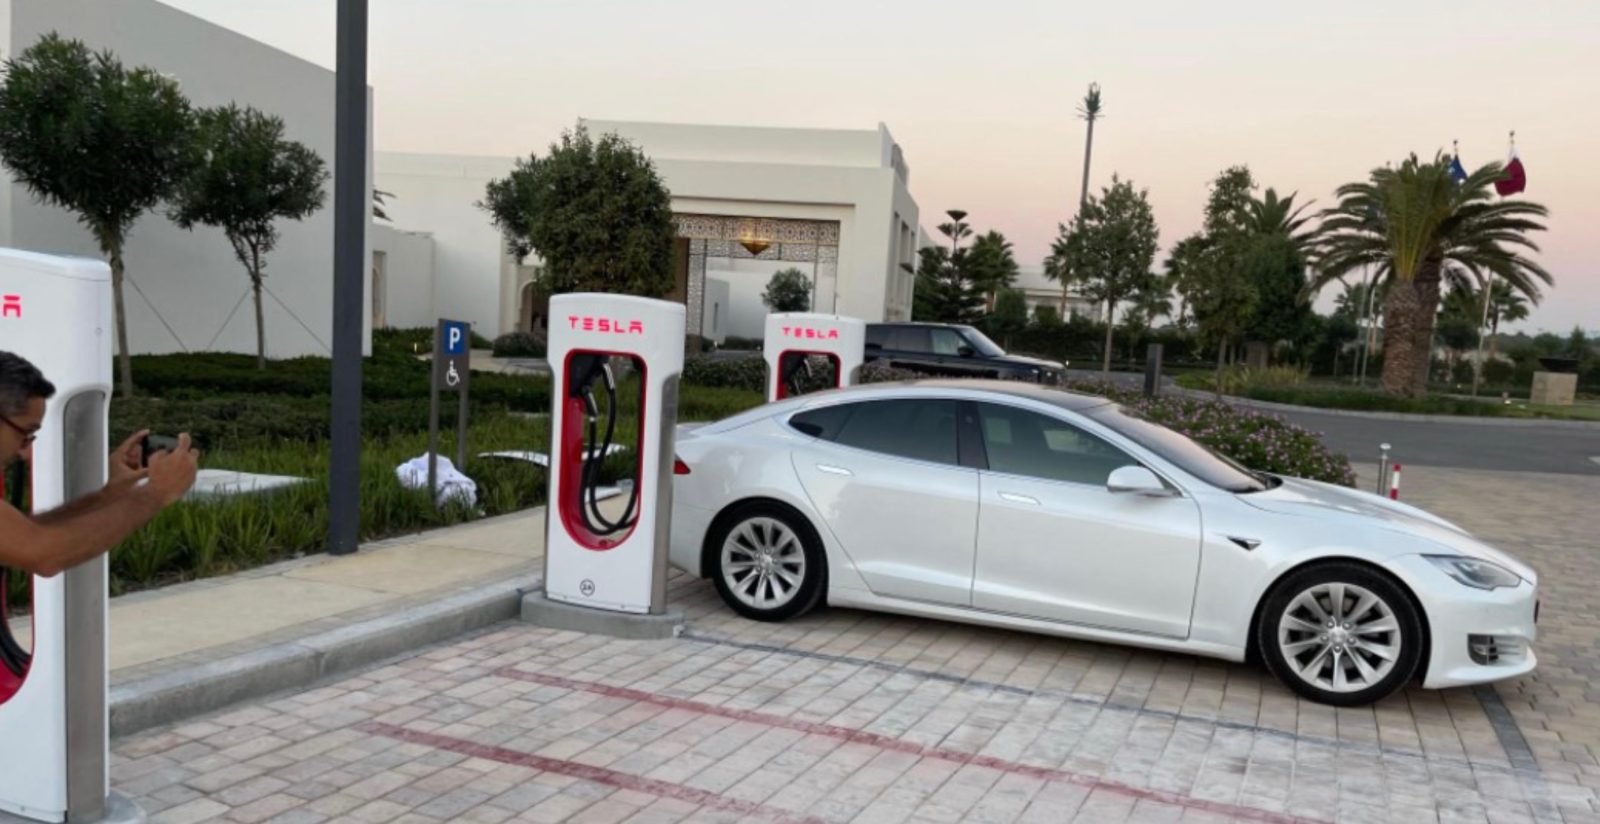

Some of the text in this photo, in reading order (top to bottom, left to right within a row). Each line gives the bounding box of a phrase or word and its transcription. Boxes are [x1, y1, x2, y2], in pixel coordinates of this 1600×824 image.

[568, 315, 644, 334] TESLA
[783, 326, 839, 339] TESLA
[449, 327, 461, 351] P
